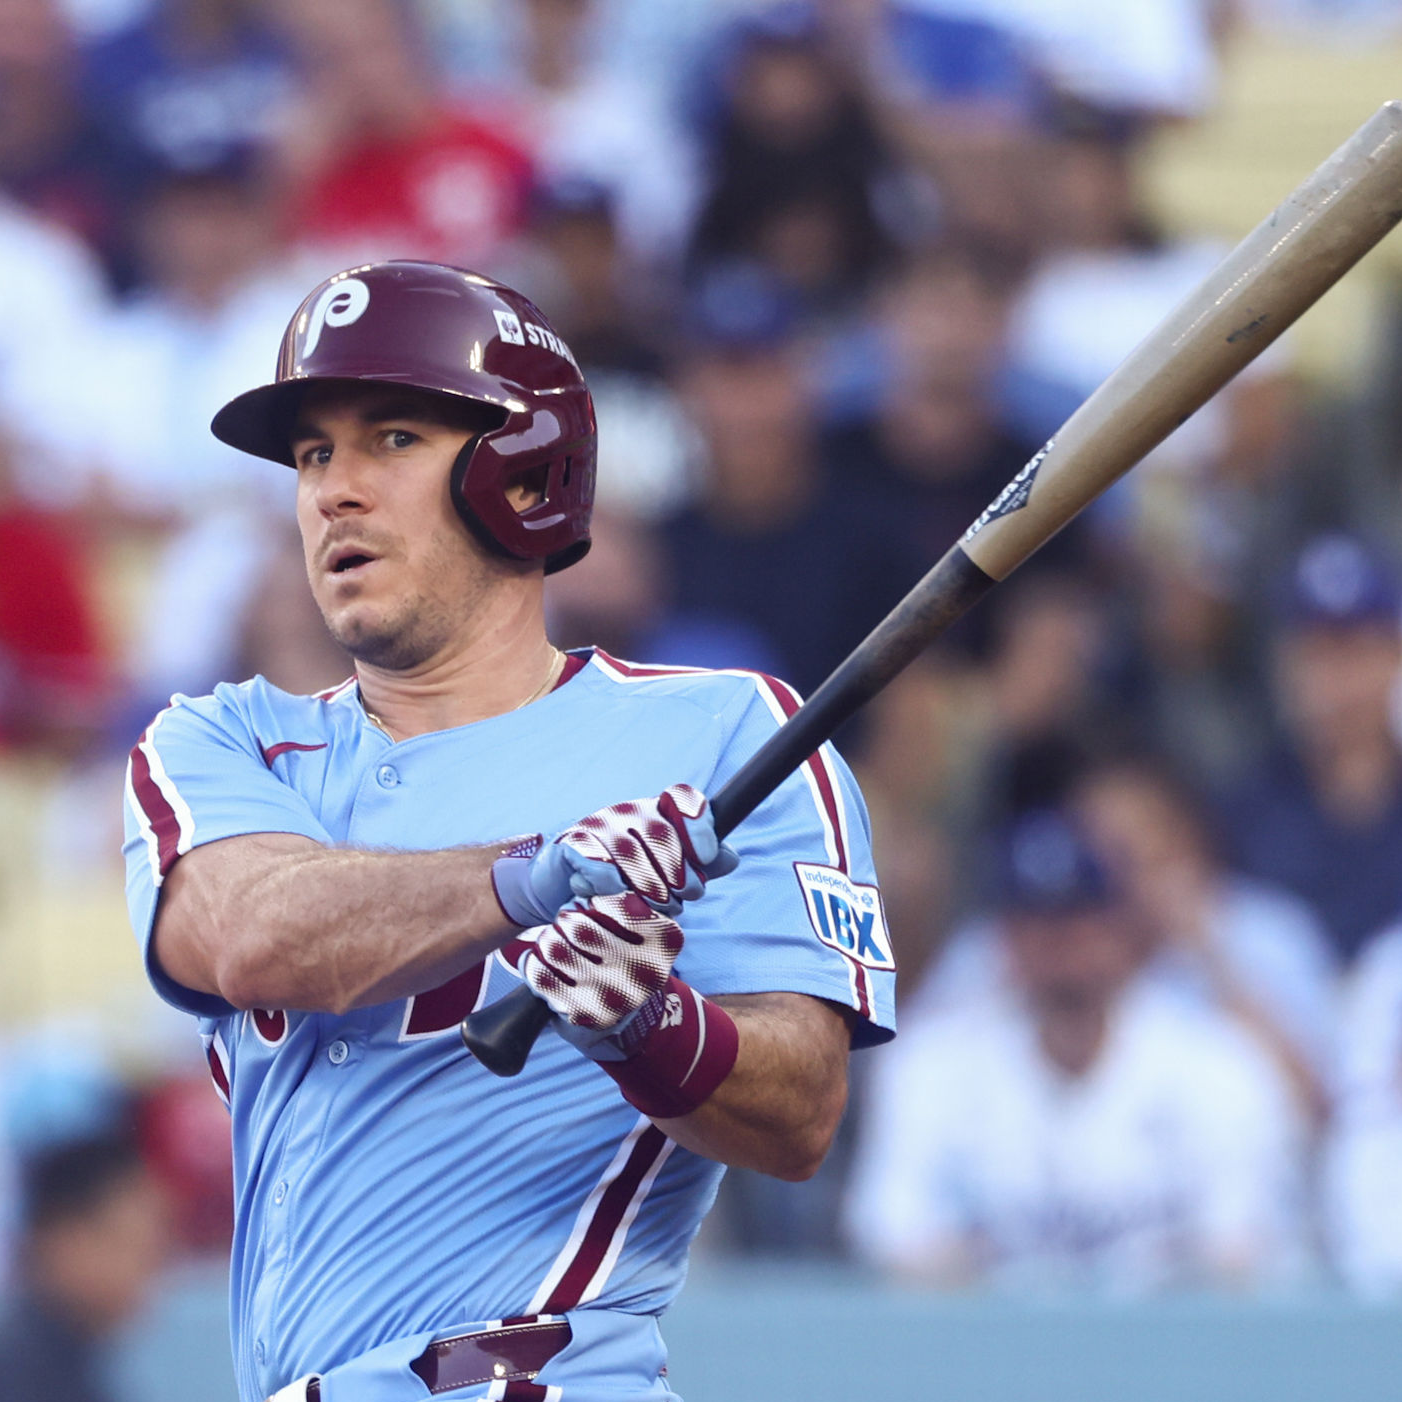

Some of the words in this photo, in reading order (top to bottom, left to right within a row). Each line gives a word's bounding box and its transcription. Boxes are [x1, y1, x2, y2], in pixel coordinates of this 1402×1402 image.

[302, 278, 370, 360] P
[524, 321, 578, 366] STRA
[810, 888, 887, 962] IBX
